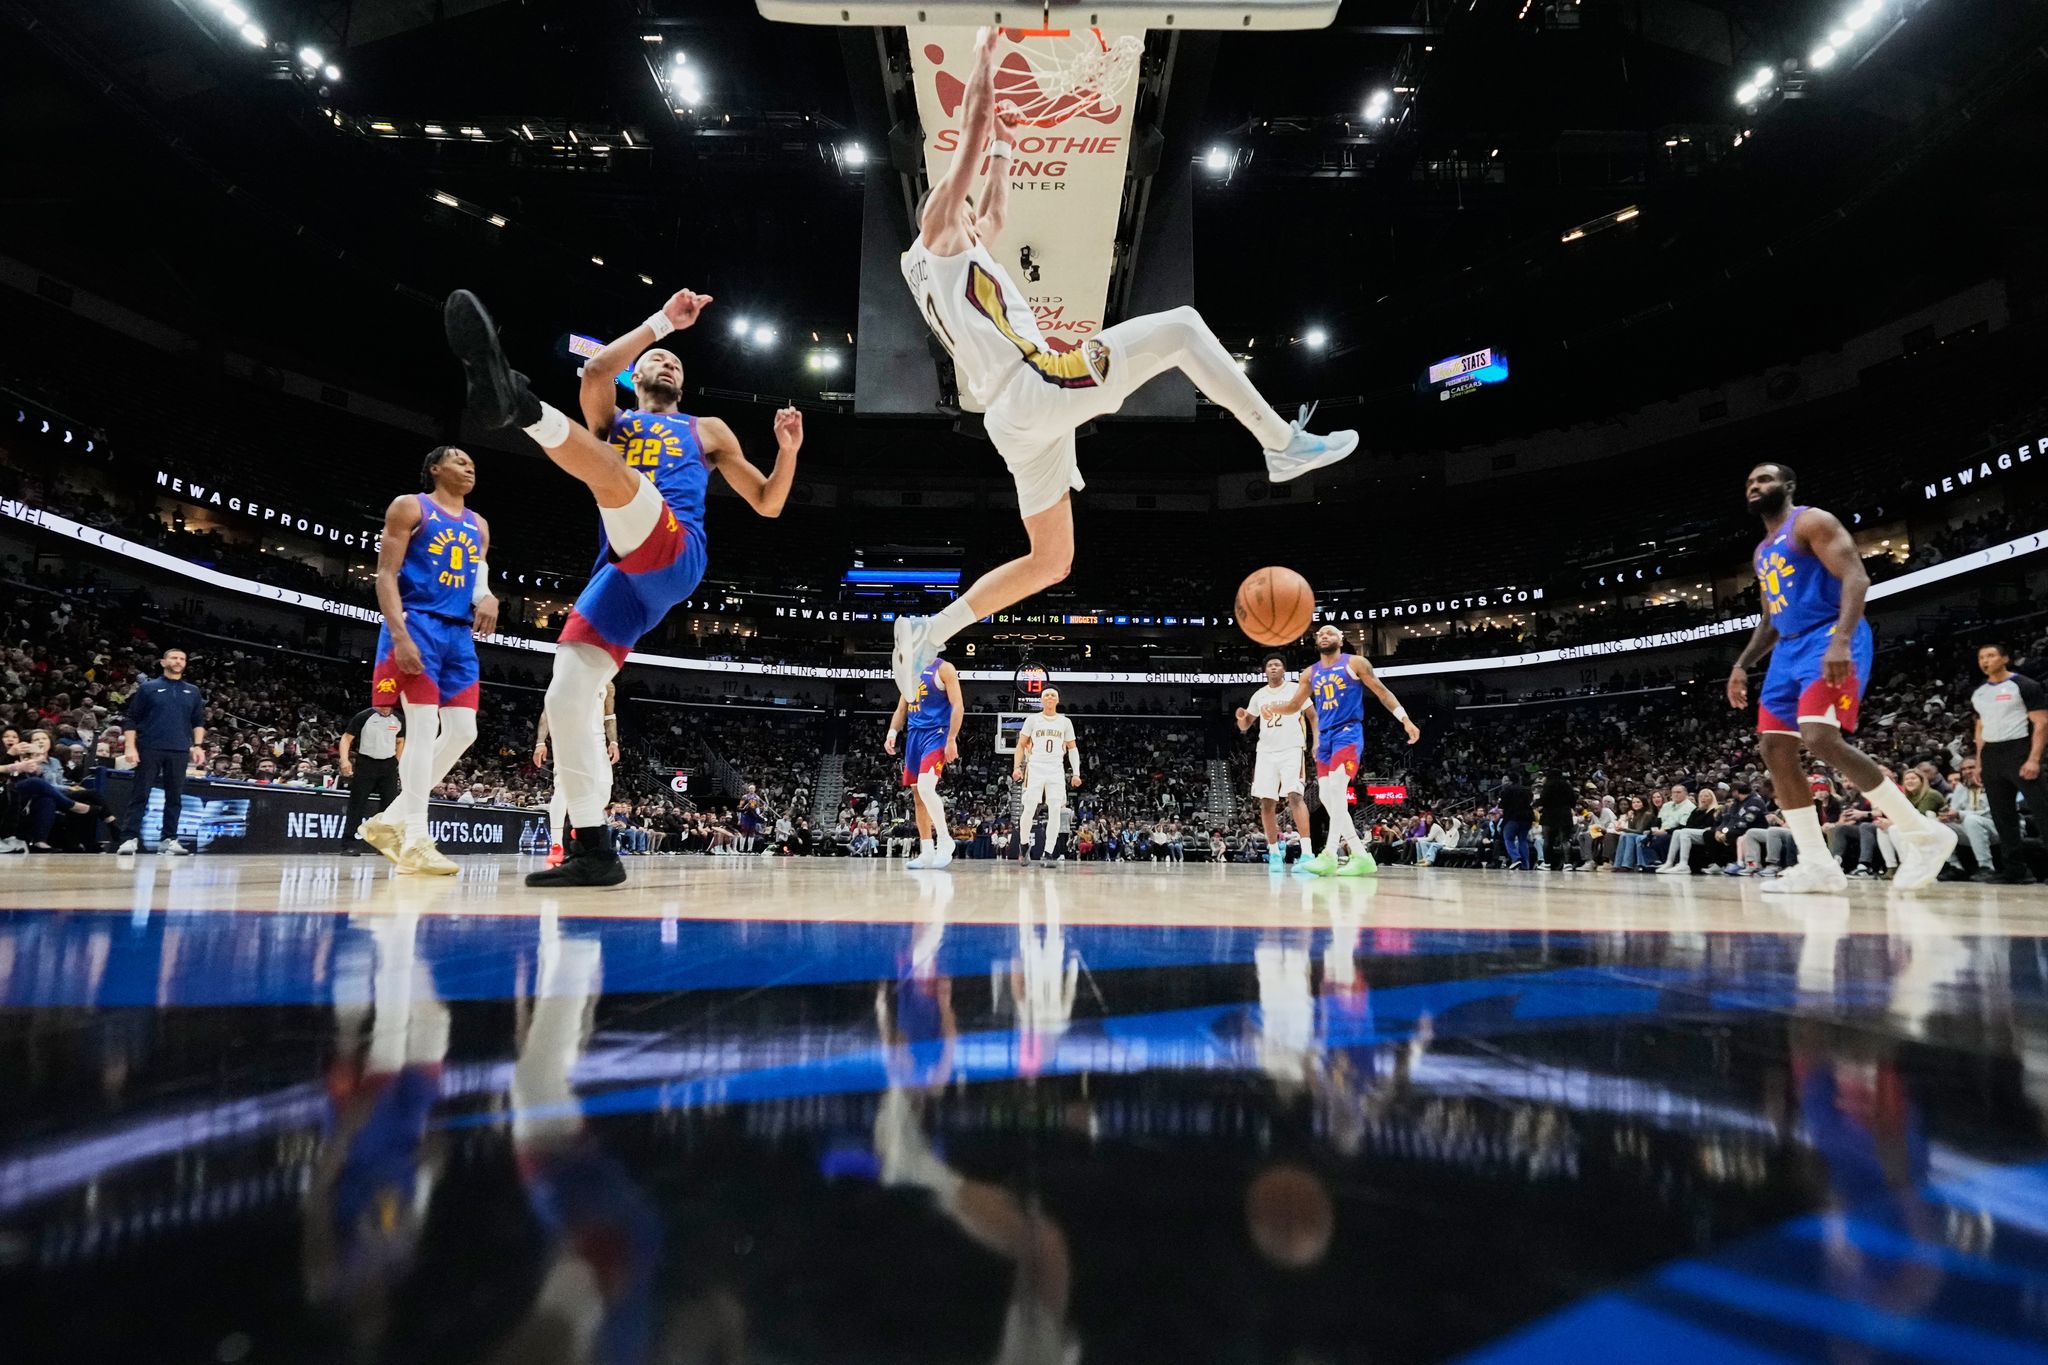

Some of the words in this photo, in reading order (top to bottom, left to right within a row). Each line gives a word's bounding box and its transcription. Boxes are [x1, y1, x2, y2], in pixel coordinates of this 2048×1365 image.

[934, 130, 1121, 153] SOTHIE
[1012, 182, 1066, 190] NTER
[1461, 352, 1486, 372] STATS
[1451, 380, 1482, 394] CAESARS
[650, 422, 683, 457] HIGH
[626, 438, 662, 466] 22
[428, 528, 456, 555] MILE
[458, 531, 480, 563] HIGH
[450, 545, 463, 570] 8
[439, 571, 465, 588] CITY
[1312, 588, 1544, 622] EWAGEPRODUCTS.COM
[776, 607, 850, 621] NEWAGE
[1069, 616, 1098, 624] NUGGETS
[1633, 636, 1654, 650] ON
[1660, 621, 1726, 645] ANOTHER
[1731, 614, 1762, 631] LEV
[825, 668, 841, 678] ON
[1208, 673, 1224, 683] ON
[1229, 671, 1268, 683] ANOTH
[1046, 739, 1053, 753] 0
[671, 775, 688, 792] G
